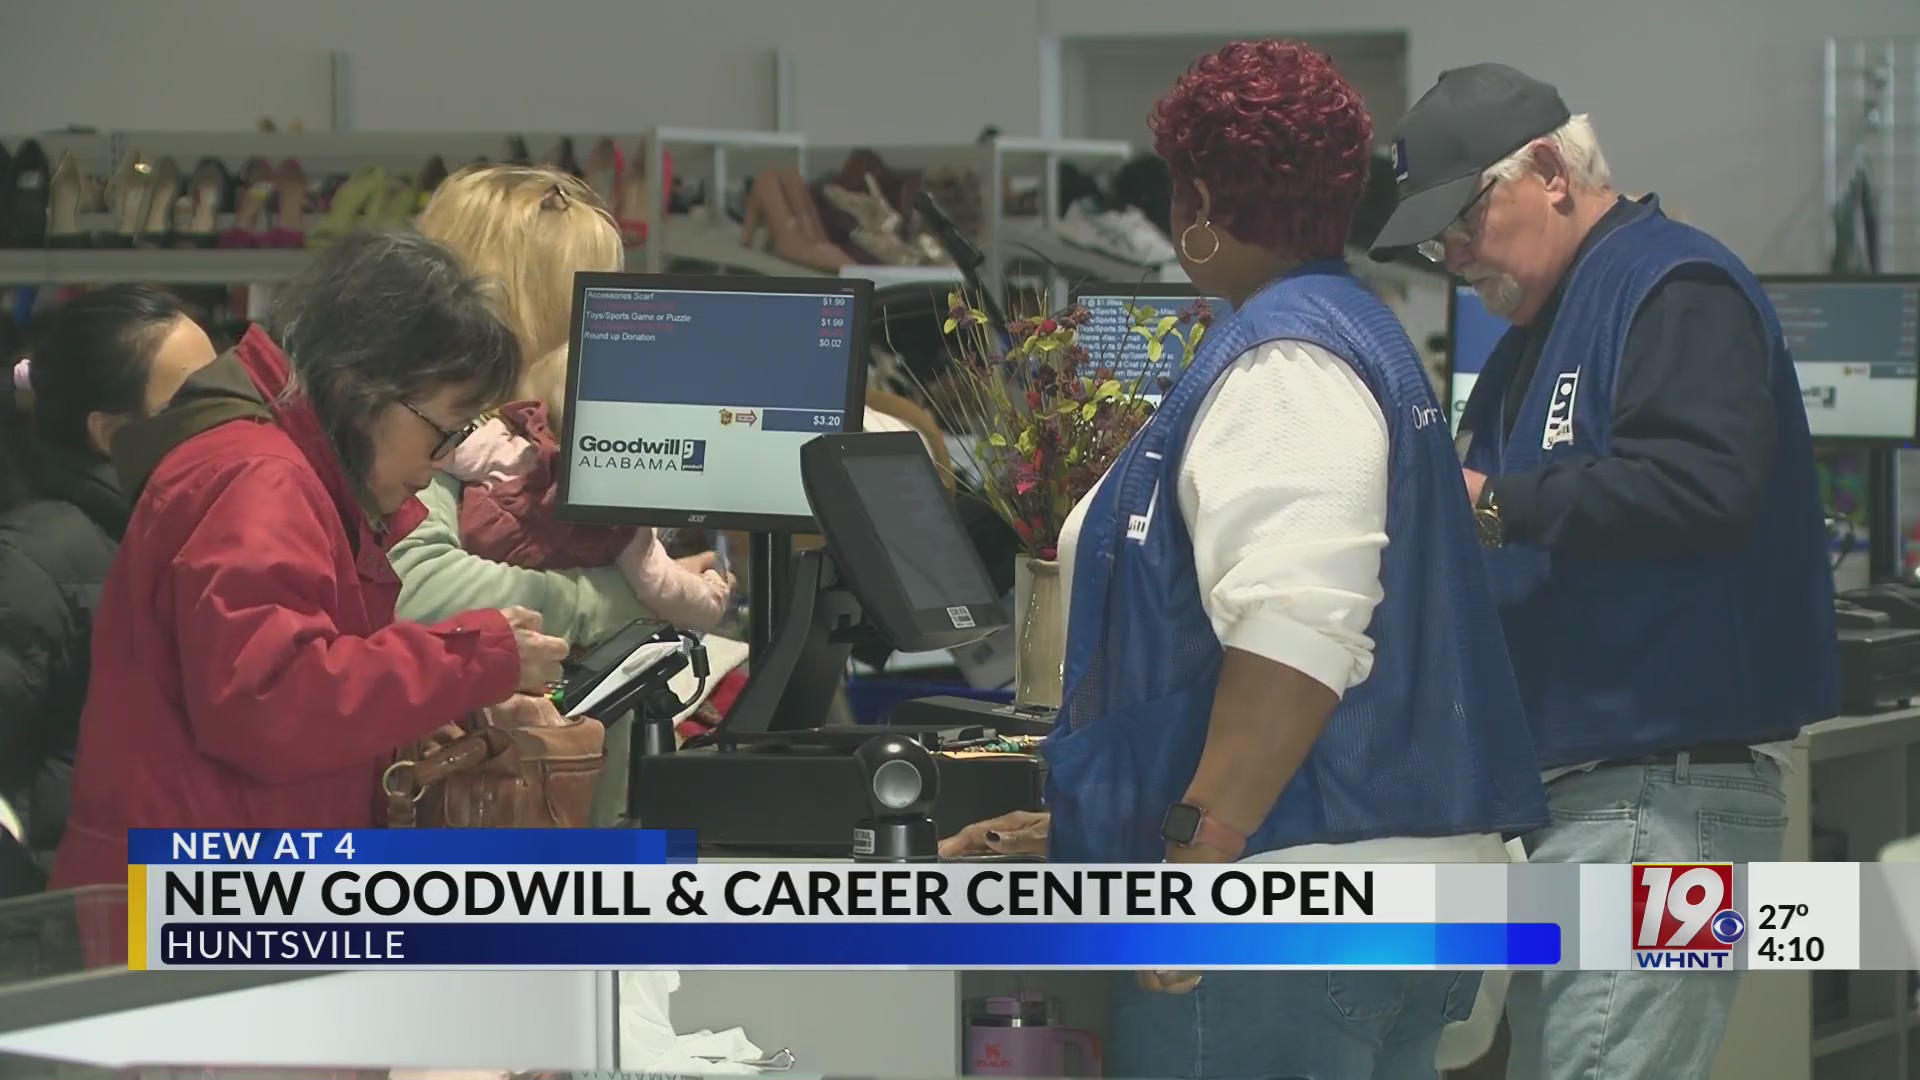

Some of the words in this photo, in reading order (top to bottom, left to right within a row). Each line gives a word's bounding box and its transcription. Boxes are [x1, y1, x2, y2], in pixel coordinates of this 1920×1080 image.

[587, 291, 632, 300] Accessories
[633, 292, 655, 300] Scarf
[586, 311, 630, 321] Toys/Sports
[631, 313, 655, 321] Game
[666, 313, 692, 323] Puzzle
[584, 332, 609, 340] Round
[622, 333, 656, 341] Donation
[819, 338, 842, 348] $0.02
[813, 415, 841, 426] $3.20
[579, 435, 680, 455] Goodwill
[579, 456, 678, 471] ALABAMA
